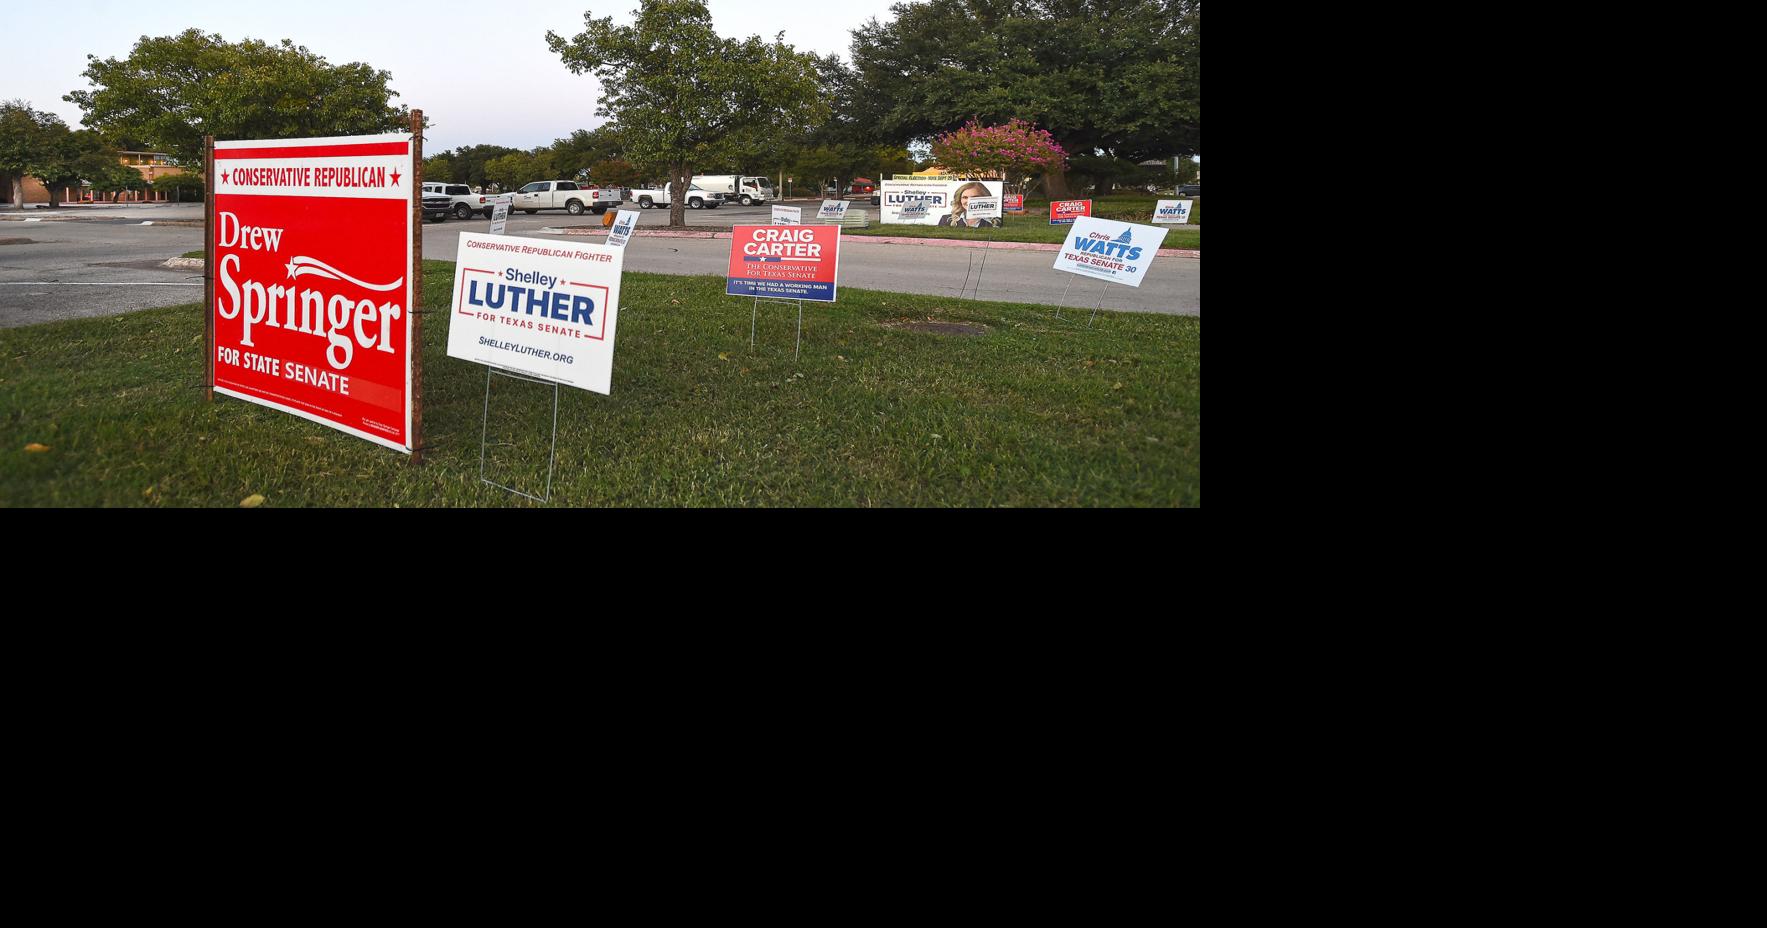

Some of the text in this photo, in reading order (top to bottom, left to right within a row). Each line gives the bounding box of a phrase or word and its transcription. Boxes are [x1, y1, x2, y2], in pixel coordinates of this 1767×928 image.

[233, 166, 386, 188] CONSERVATIVE REPUBLICAN
[219, 211, 284, 252] Drew
[752, 229, 814, 242] CRAIG
[1089, 232, 1110, 241] Chris
[467, 240, 613, 263] CONSERVATIVE REPUBLICAN FIGHTER
[743, 242, 821, 257] CARTER
[1074, 236, 1143, 261] WATTS
[1080, 251, 1112, 261] REPUBLICAN
[762, 264, 817, 272] CONSERVATIVE
[1064, 253, 1089, 264] TEXAS
[1090, 258, 1125, 271] SENATE
[1125, 265, 1137, 273] 30
[505, 268, 558, 289] Shelley
[762, 270, 786, 278] TEXAS
[788, 271, 816, 279] SENATE
[218, 254, 401, 369] Springer
[468, 279, 595, 326] LUTHER
[476, 311, 581, 339] FOR TEXAS SENATE
[478, 336, 574, 365] SHELLEYLUTHER.ORG
[218, 346, 350, 396] FOR STATE SENATE
